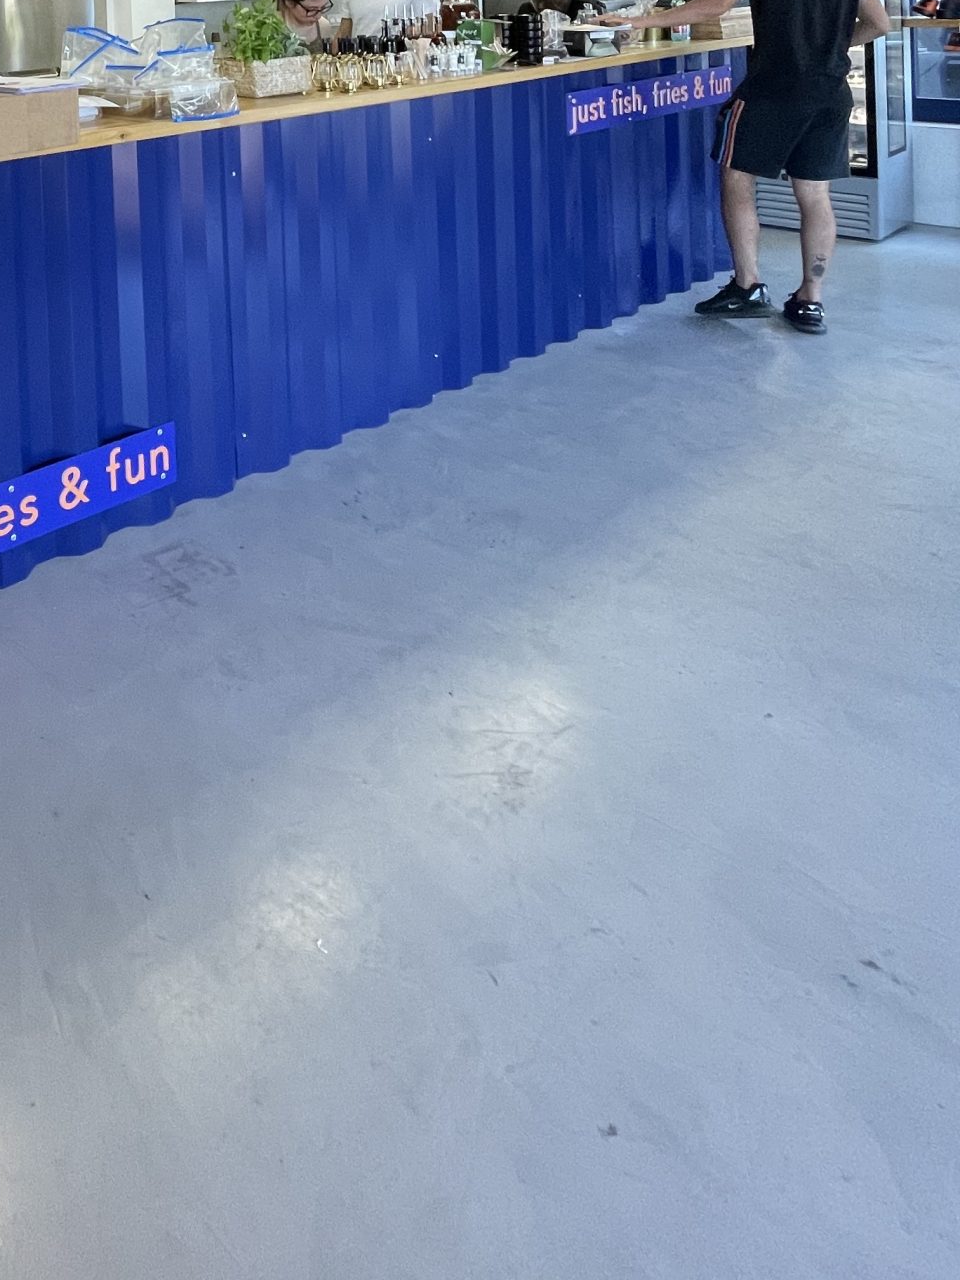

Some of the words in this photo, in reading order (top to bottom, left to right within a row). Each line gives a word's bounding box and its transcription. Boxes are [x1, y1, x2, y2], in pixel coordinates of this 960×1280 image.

[569, 97, 606, 134] just
[611, 86, 647, 116] fish,
[652, 81, 688, 107] fries
[694, 76, 705, 99] &
[709, 71, 732, 96] fun
[58, 466, 90, 510] &
[106, 444, 170, 491] fun
